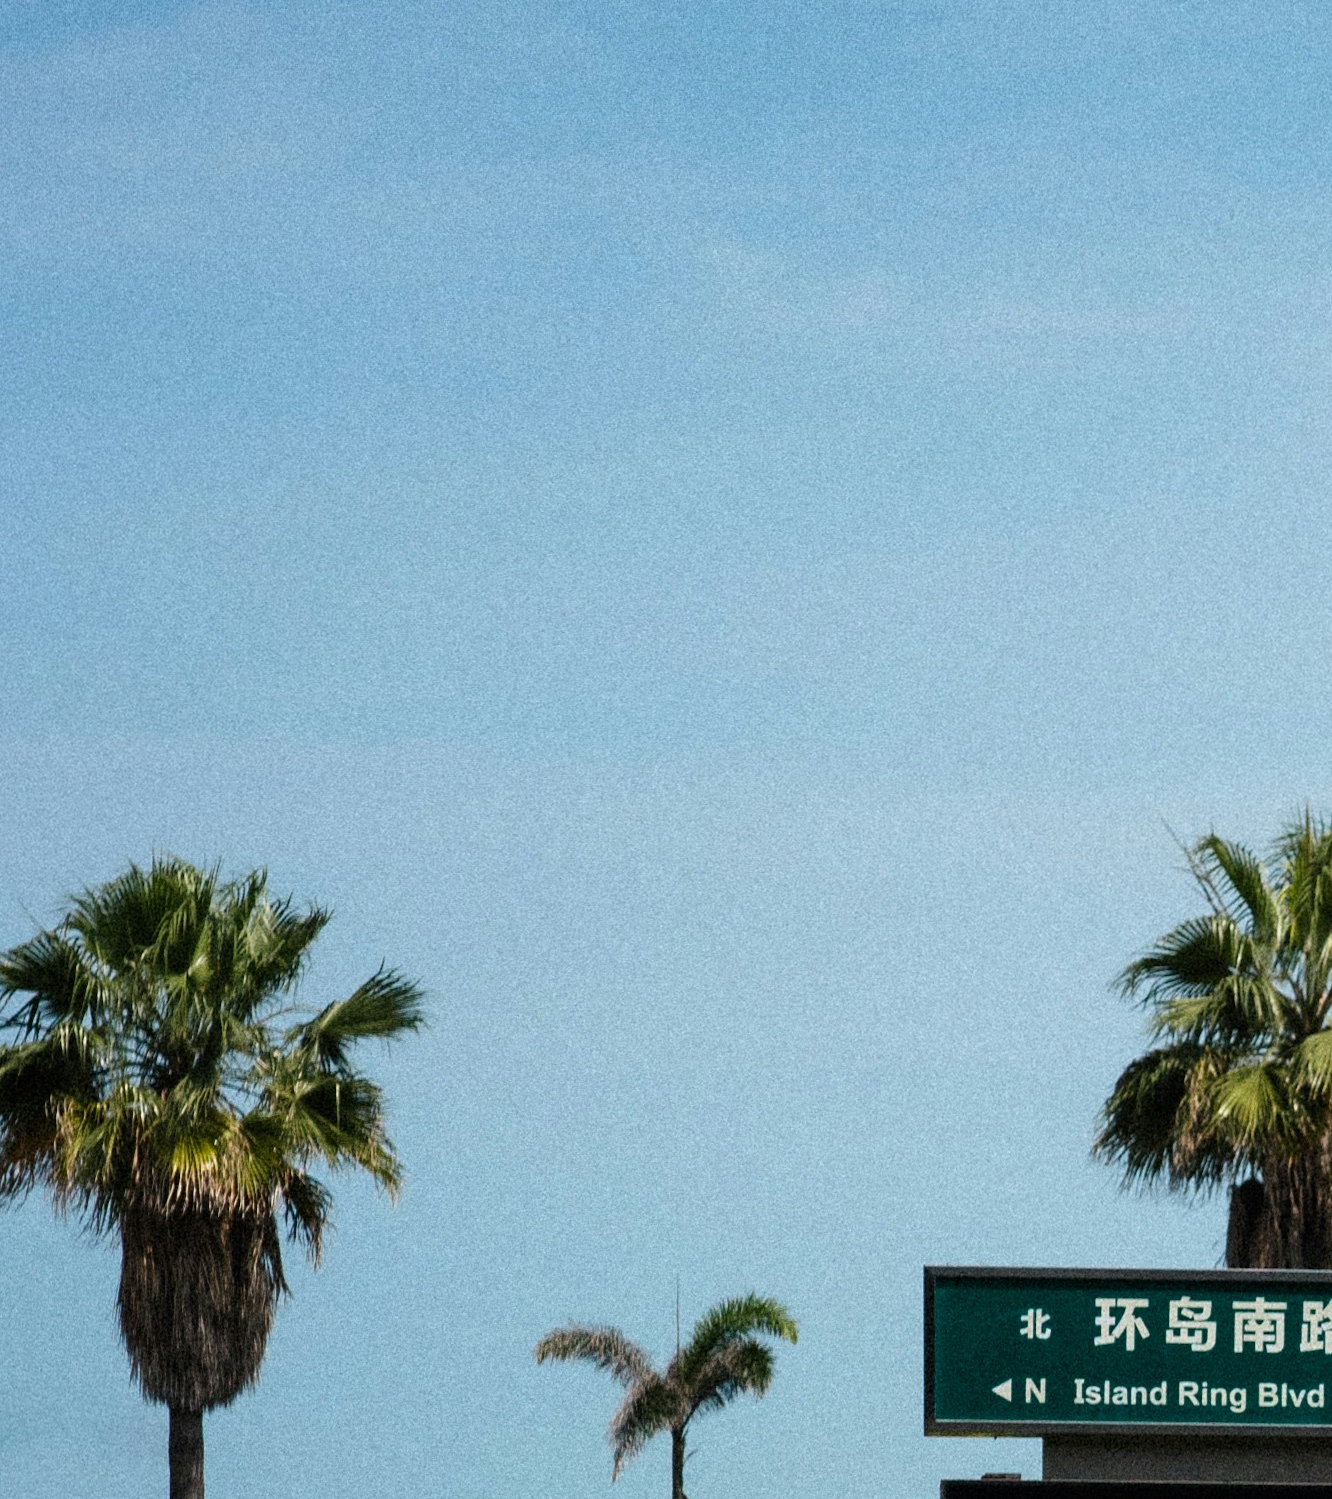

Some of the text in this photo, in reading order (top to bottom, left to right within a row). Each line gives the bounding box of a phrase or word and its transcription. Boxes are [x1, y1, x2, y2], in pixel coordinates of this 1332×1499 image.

[1020, 1307, 1051, 1340] 北
[1025, 1377, 1046, 1404] N
[1073, 1378, 1167, 1405] Island
[1178, 1380, 1248, 1414] Ring
[1257, 1382, 1325, 1408] Blvd
